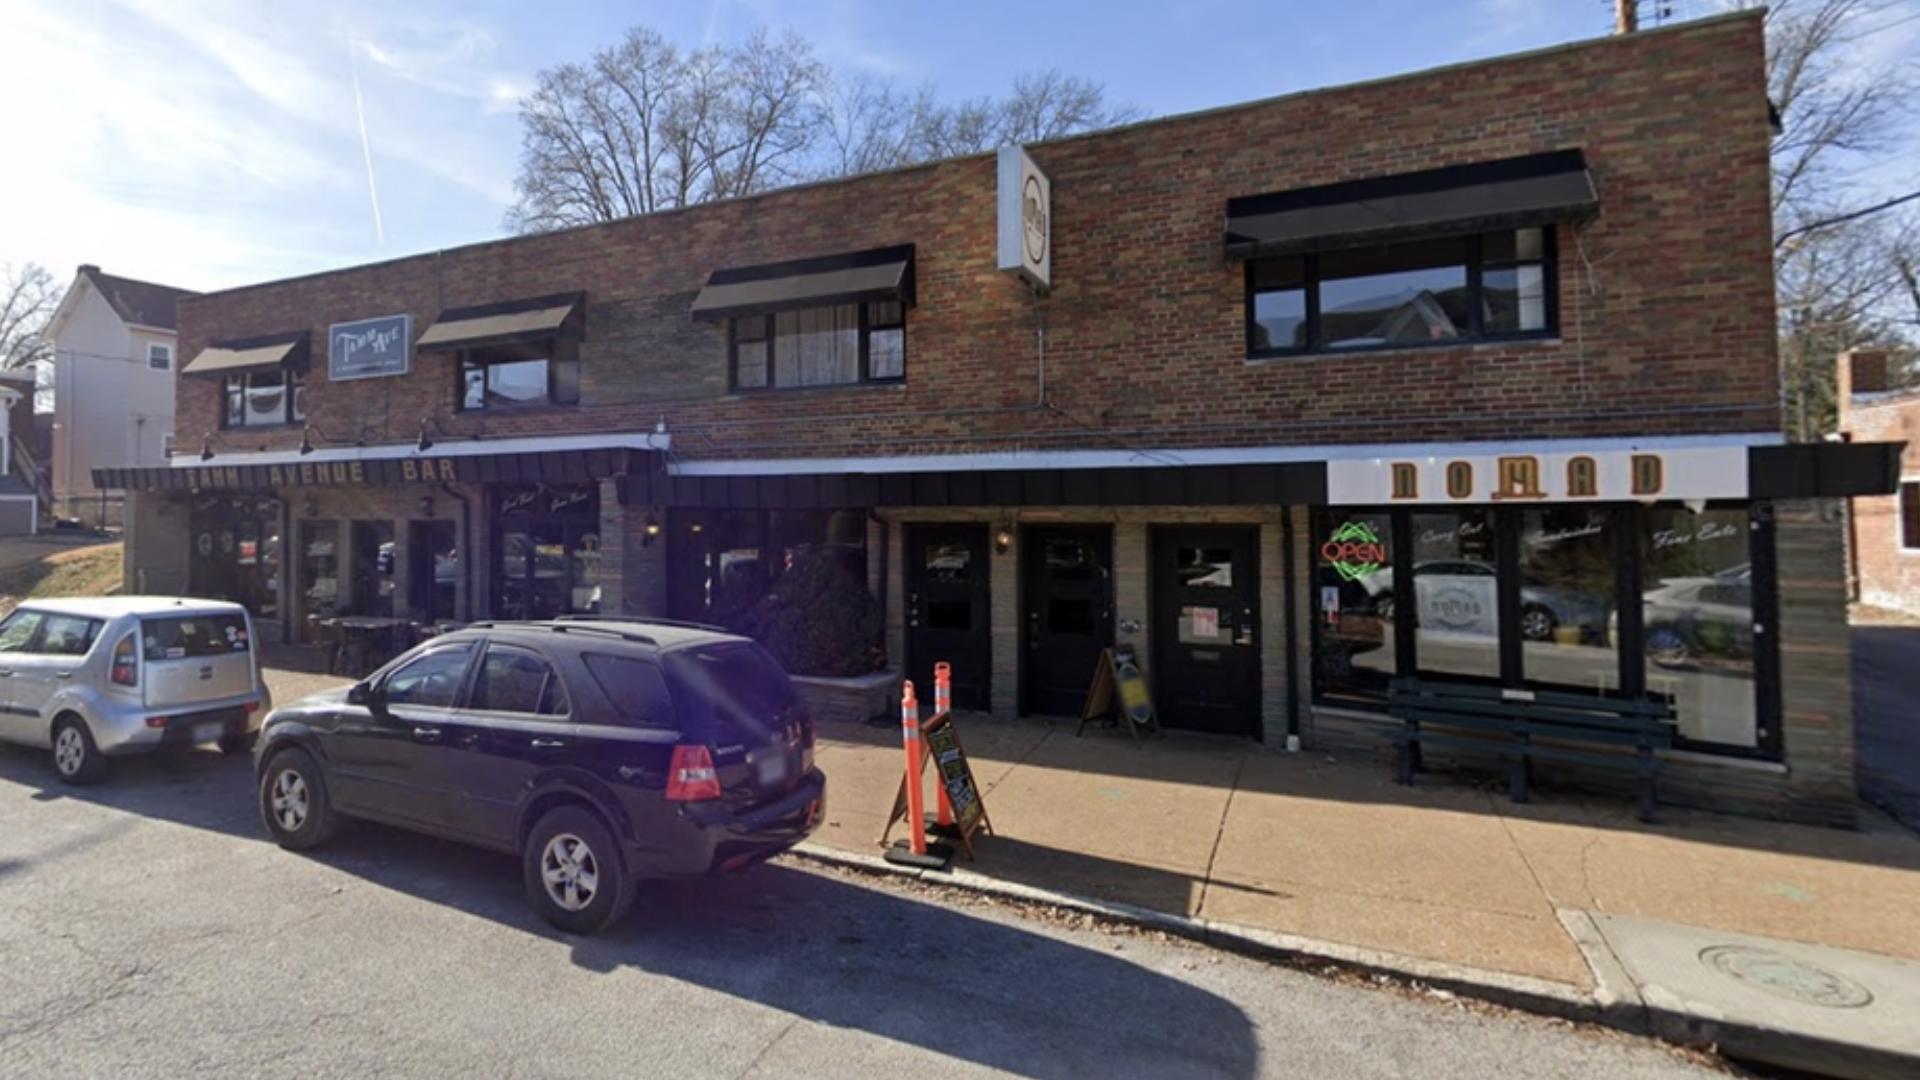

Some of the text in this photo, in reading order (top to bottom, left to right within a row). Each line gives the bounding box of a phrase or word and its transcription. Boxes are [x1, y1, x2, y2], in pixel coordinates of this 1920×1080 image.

[371, 325, 401, 353] AVE
[270, 461, 364, 485] AVENUE
[402, 458, 457, 481] BAR
[1391, 455, 1663, 500] NOMAD
[1321, 542, 1385, 562] OPEN
